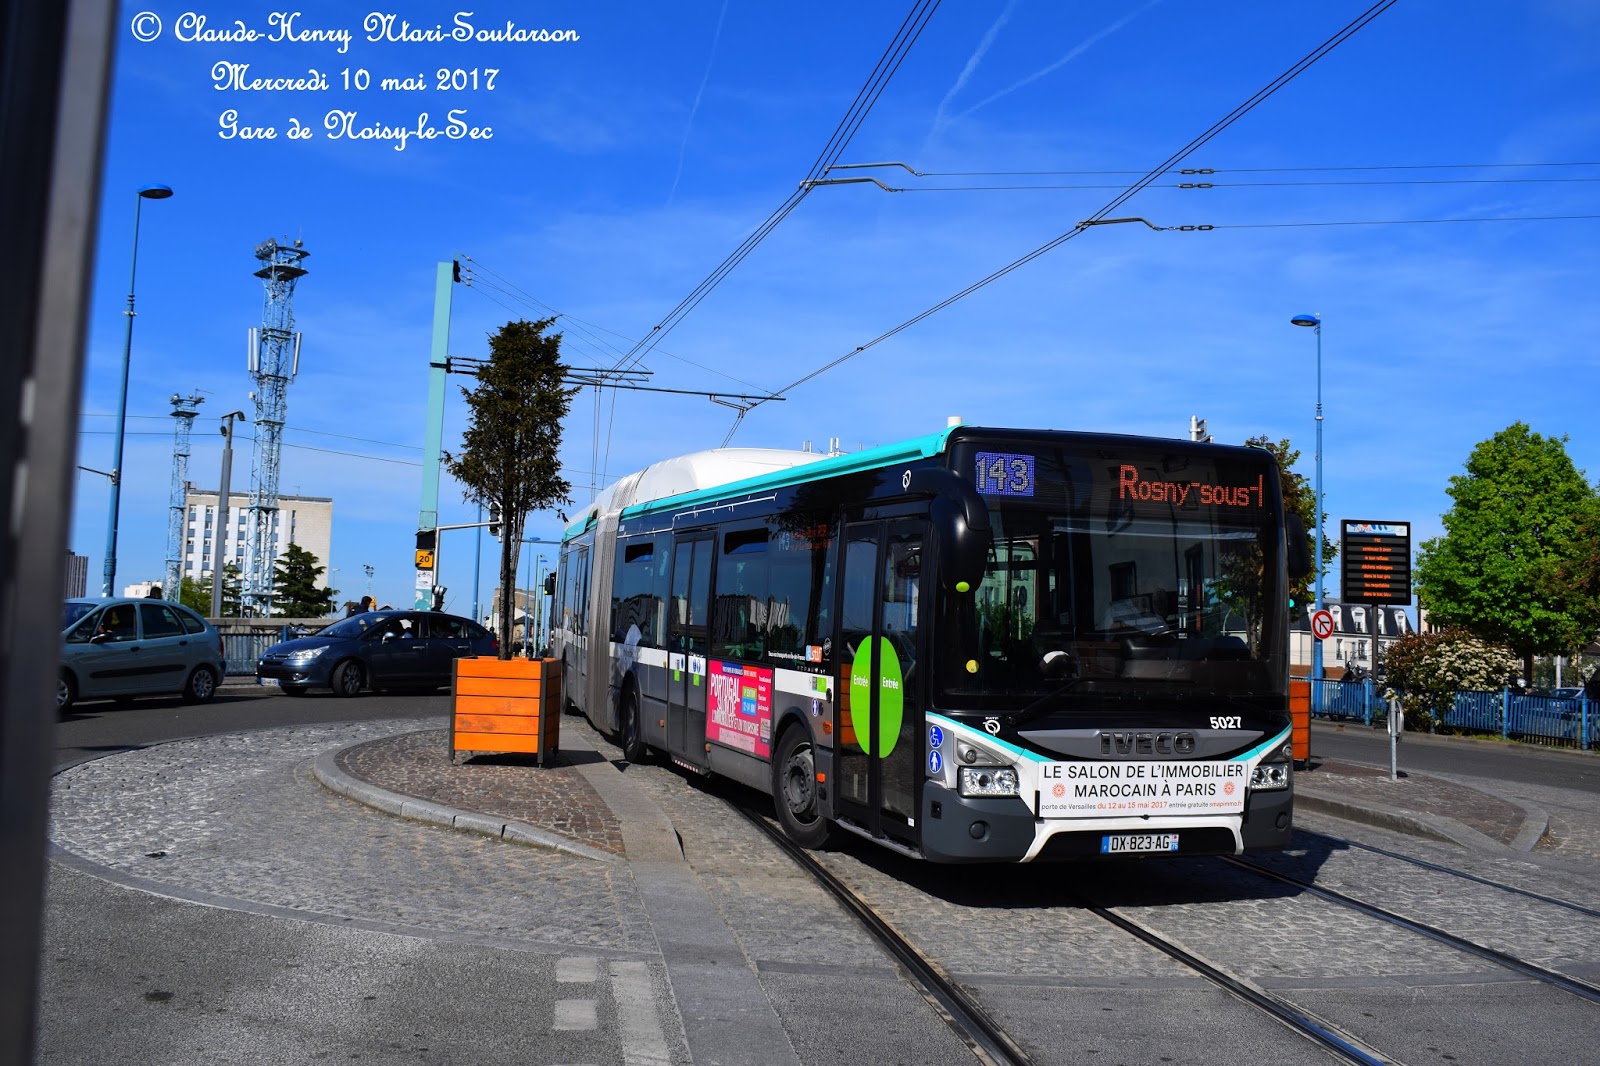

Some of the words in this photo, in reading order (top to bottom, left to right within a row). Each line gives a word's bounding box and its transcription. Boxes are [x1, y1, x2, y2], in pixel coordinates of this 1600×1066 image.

[976, 456, 1030, 493] 143
[1119, 464, 1264, 507] Rosny-sous-
[711, 673, 740, 702] PORTUGAL
[854, 674, 868, 687] Entrée
[882, 677, 898, 689] Entrée
[1210, 716, 1242, 729] 5027
[1100, 732, 1196, 754] IVECO
[1044, 766, 1062, 779] LE
[1067, 765, 1120, 778] SALON
[1126, 765, 1145, 778] DE
[1151, 764, 1243, 778] L'IMMOBILIER
[1074, 784, 1157, 798] MAROCAIN
[1161, 780, 1171, 796] À
[1176, 783, 1216, 796] PARIS
[1111, 836, 1170, 850] DX-823-AG
